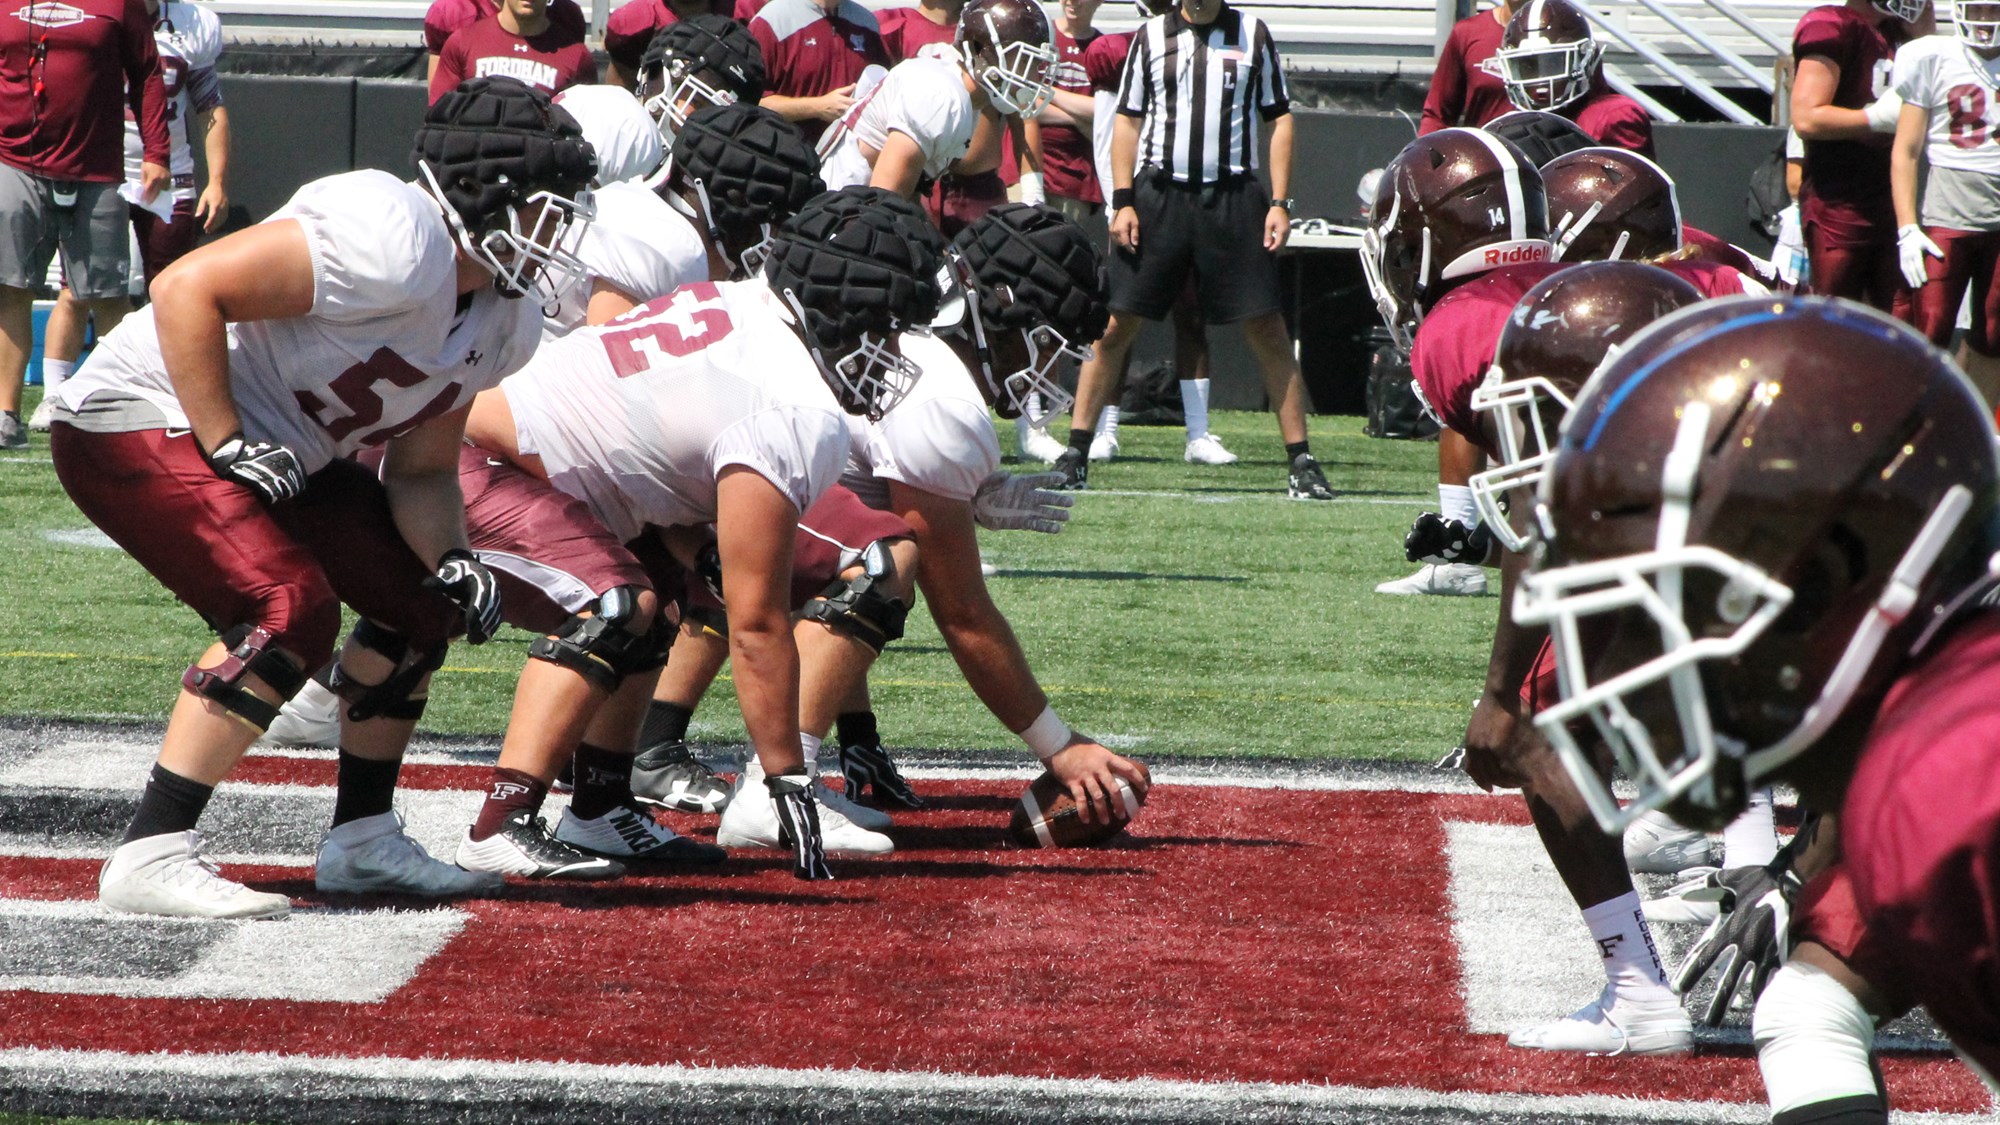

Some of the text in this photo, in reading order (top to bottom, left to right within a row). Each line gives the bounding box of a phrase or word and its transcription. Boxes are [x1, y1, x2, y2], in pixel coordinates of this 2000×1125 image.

[476, 57, 557, 90] FORDHAM
[1224, 72, 1235, 89] L
[1947, 84, 2000, 149] 8
[1488, 207, 1505, 226] 14
[1484, 245, 1550, 265] Riddell
[490, 782, 529, 800] F
[610, 812, 661, 853] NIKE
[1598, 934, 1624, 958] F
